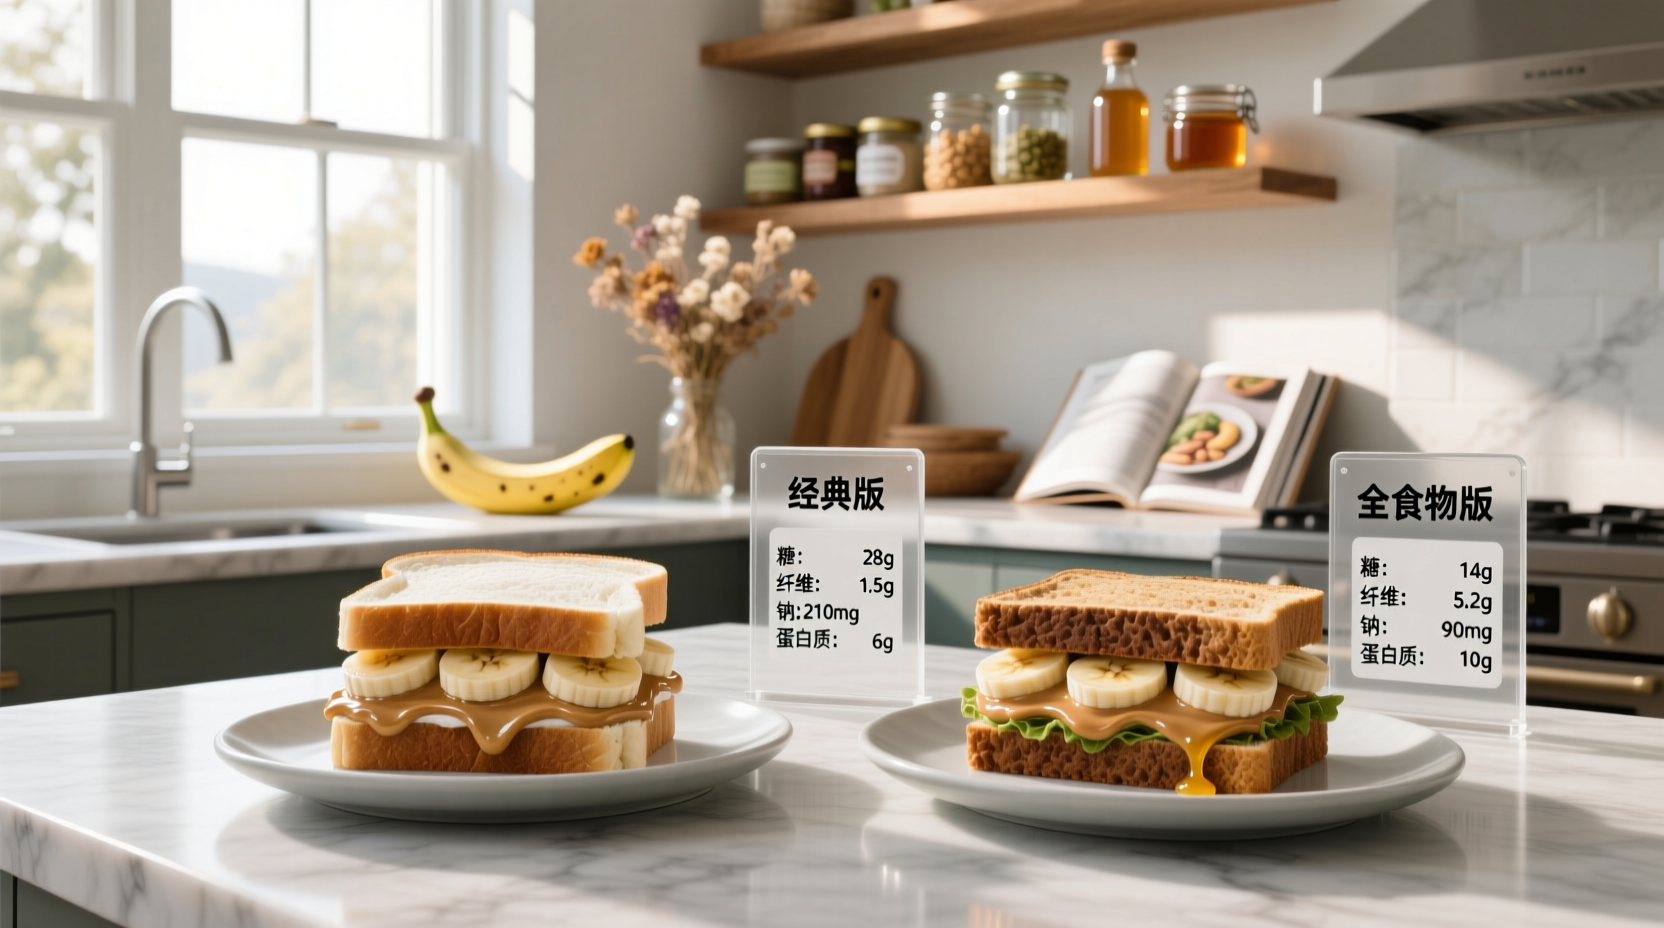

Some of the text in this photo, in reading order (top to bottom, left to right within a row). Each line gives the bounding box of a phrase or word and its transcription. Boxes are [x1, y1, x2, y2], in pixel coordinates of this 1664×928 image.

[788, 475, 885, 511] 经典版
[1357, 483, 1494, 522] 全食物版
[862, 548, 894, 570] 28g
[1459, 561, 1493, 585] 14g
[859, 576, 894, 598] 1.5g
[1453, 590, 1493, 615] 5.2g
[872, 632, 894, 654] 6g
[1441, 620, 1493, 645] 90mg
[1460, 650, 1492, 675] 10g
